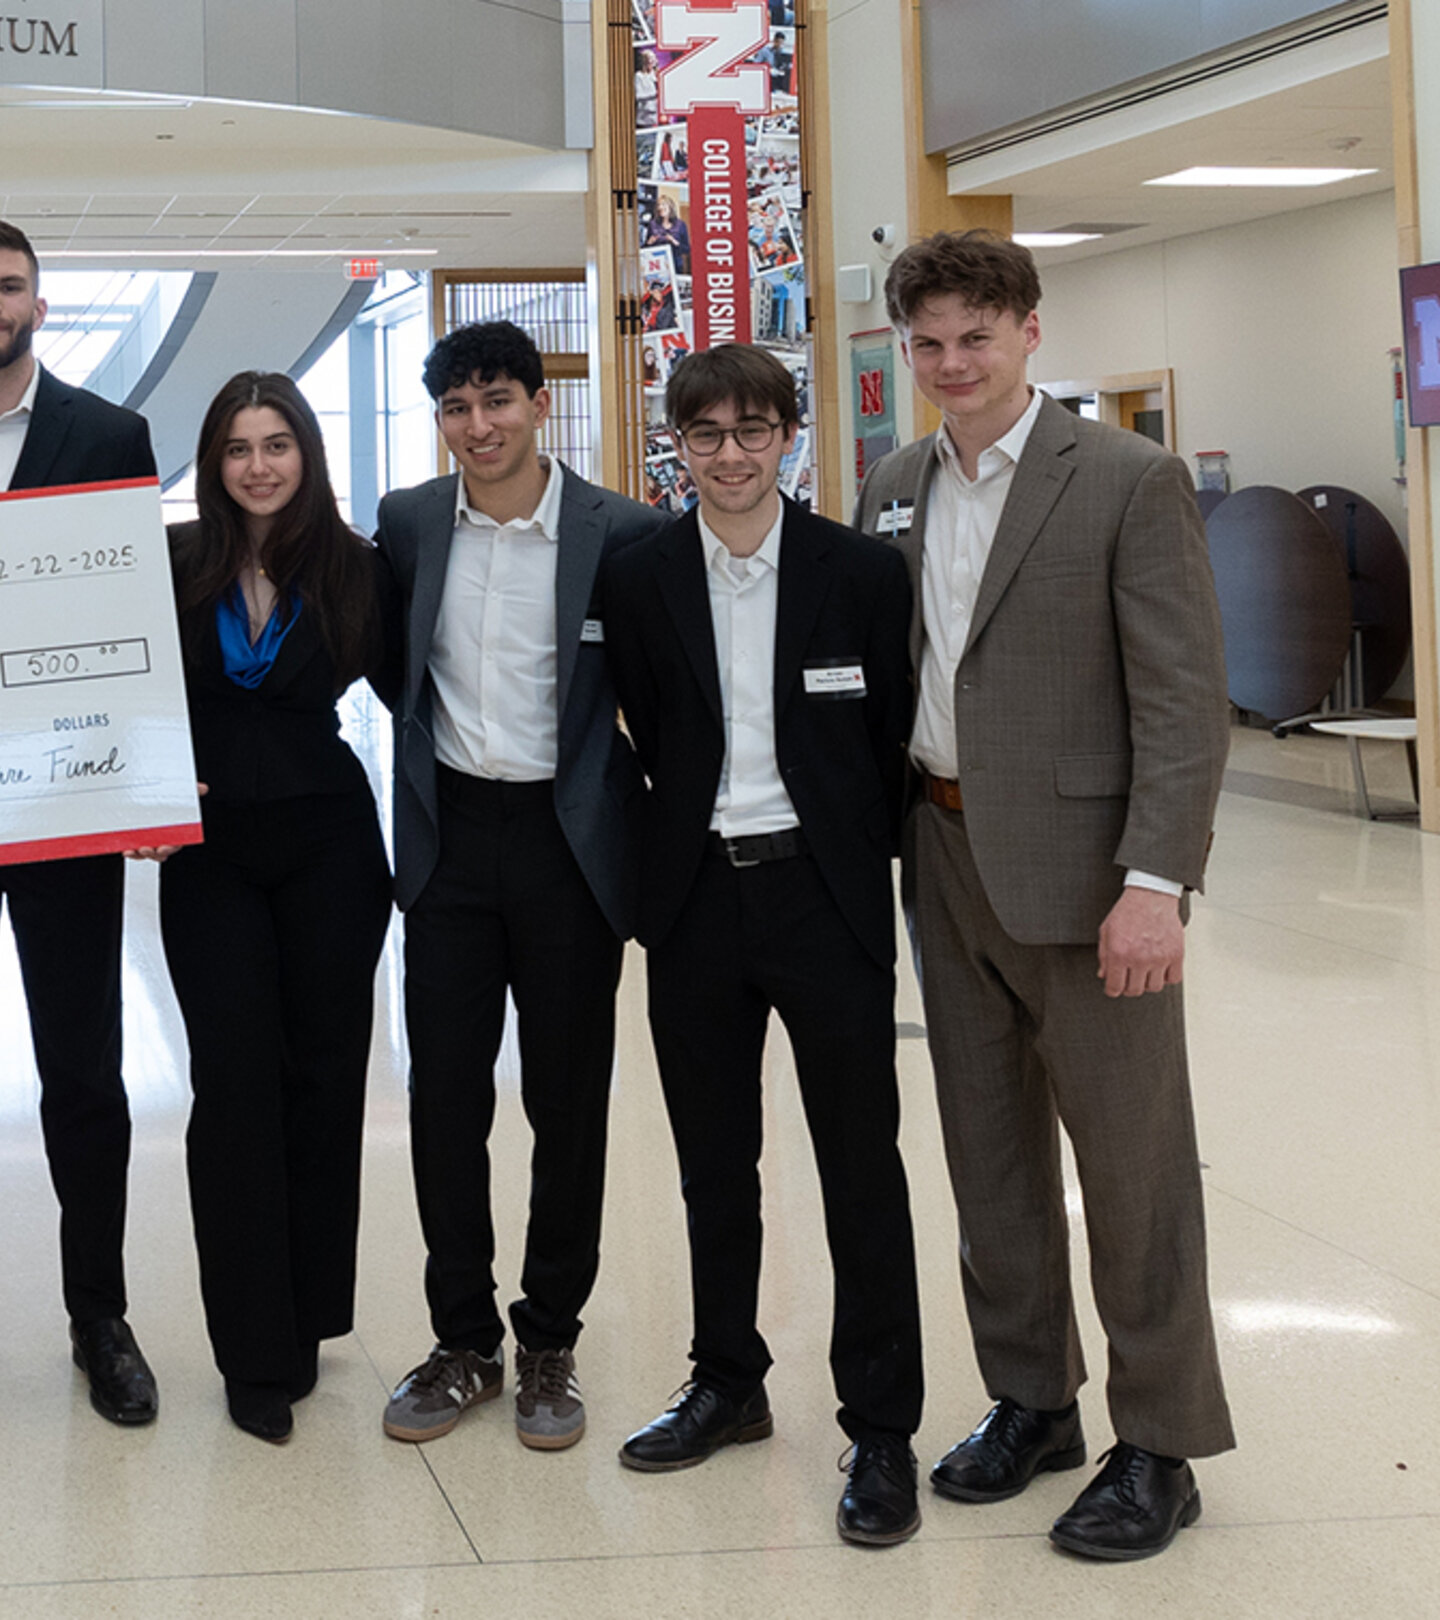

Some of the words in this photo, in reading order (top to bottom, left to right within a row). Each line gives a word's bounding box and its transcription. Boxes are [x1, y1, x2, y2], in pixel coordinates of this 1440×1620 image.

[656, 0, 771, 115] N
[702, 138, 733, 233] COLLEGE
[351, 258, 378, 278] EXIT
[705, 238, 734, 267] OF
[707, 272, 736, 348] BUSIN
[859, 368, 885, 417] N
[52, 712, 110, 732] DOLLARS
[42, 744, 127, 783] Fund
